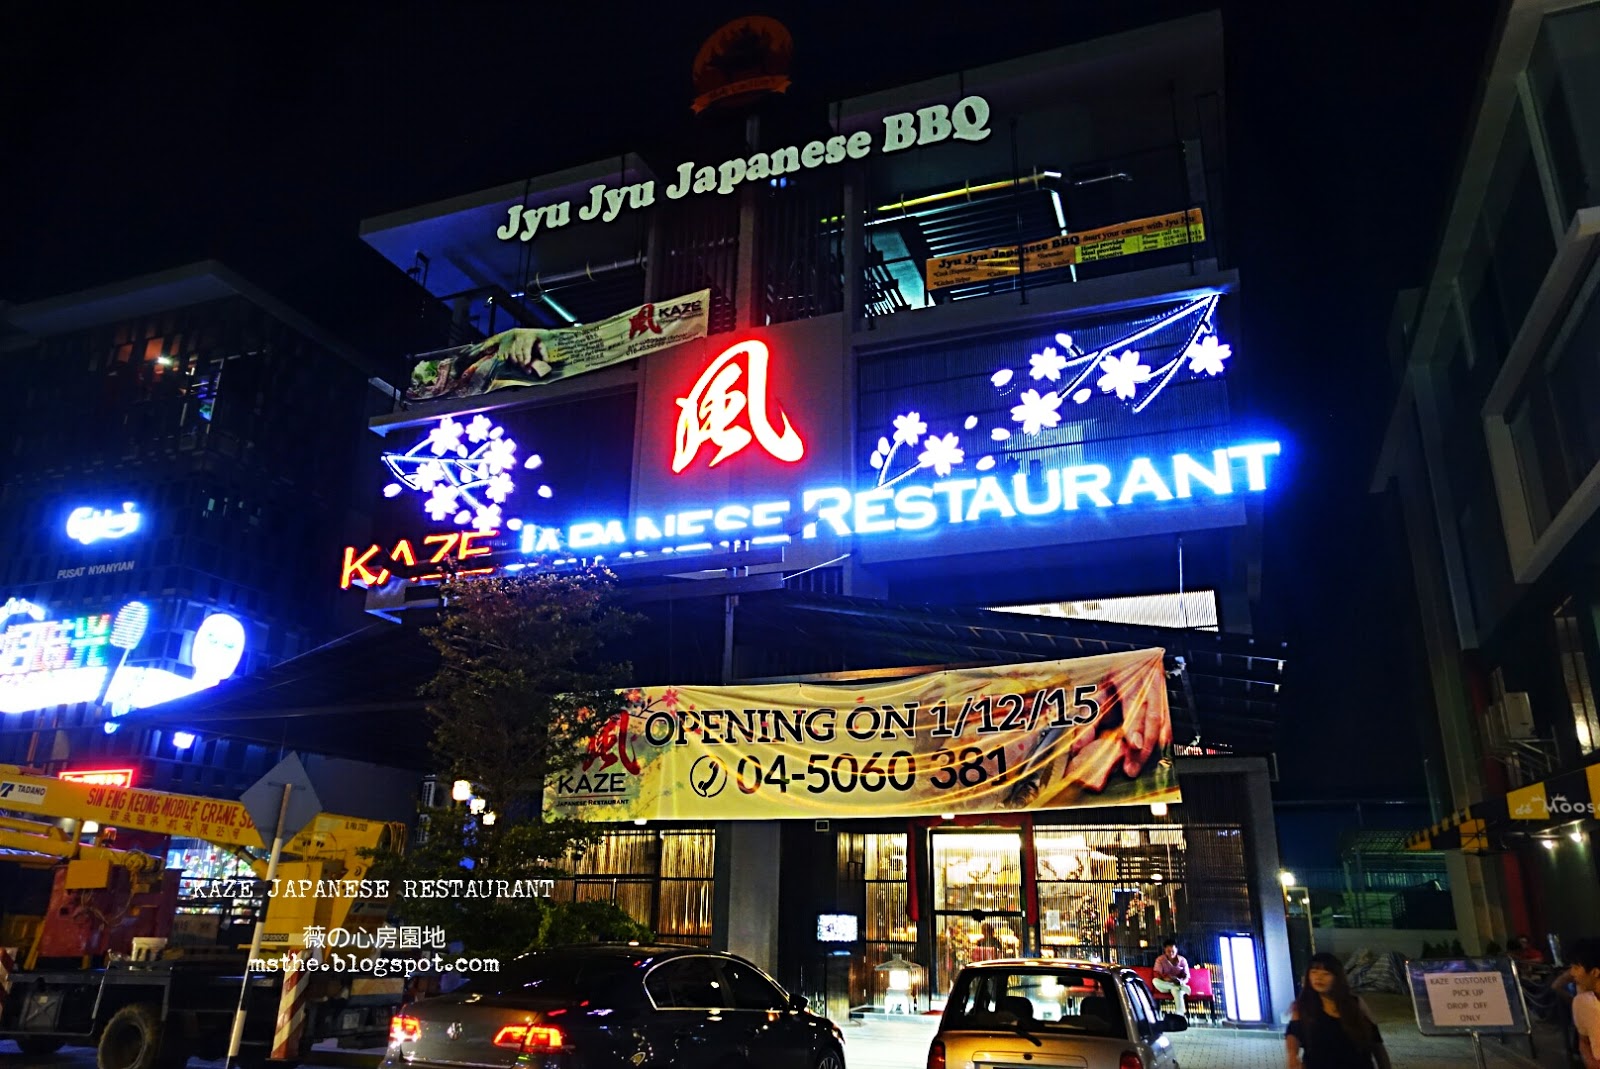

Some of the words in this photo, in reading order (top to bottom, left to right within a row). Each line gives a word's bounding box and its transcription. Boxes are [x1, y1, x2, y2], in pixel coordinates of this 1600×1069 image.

[497, 203, 571, 242] Jyu
[579, 180, 655, 223] Jyu
[666, 130, 871, 200] Japanese
[881, 95, 992, 154] BBQ
[938, 258, 962, 269] Jyu
[964, 254, 988, 265] Jyu
[1052, 235, 1080, 248] BBQ
[1102, 231, 1119, 240] your
[1121, 226, 1144, 235] career
[1147, 221, 1163, 230] with
[659, 299, 702, 318] KAZE
[339, 529, 500, 590] KAZE
[802, 441, 1281, 538] RESTAURANT
[57, 567, 86, 579] PUSAT
[88, 561, 135, 575] NYANYIAN
[645, 706, 838, 746] OPENING
[844, 701, 919, 741] ON
[929, 684, 1100, 738] 1/12/15
[736, 750, 917, 795] 04-5060
[930, 745, 1010, 790] 381
[18, 785, 46, 796] TADANO
[558, 773, 626, 794] KAZE
[87, 788, 106, 806] SIN
[106, 790, 127, 809] ENG
[128, 792, 160, 814] KEONG
[161, 797, 200, 820] MOBILE
[201, 802, 239, 826] CRANE
[1430, 977, 1449, 985] KAZE
[1455, 976, 1498, 985] CUSTOMER
[1452, 989, 1470, 997] PICK
[1446, 1002, 1469, 1010] DROP
[1460, 1014, 1482, 1022] ONLY
